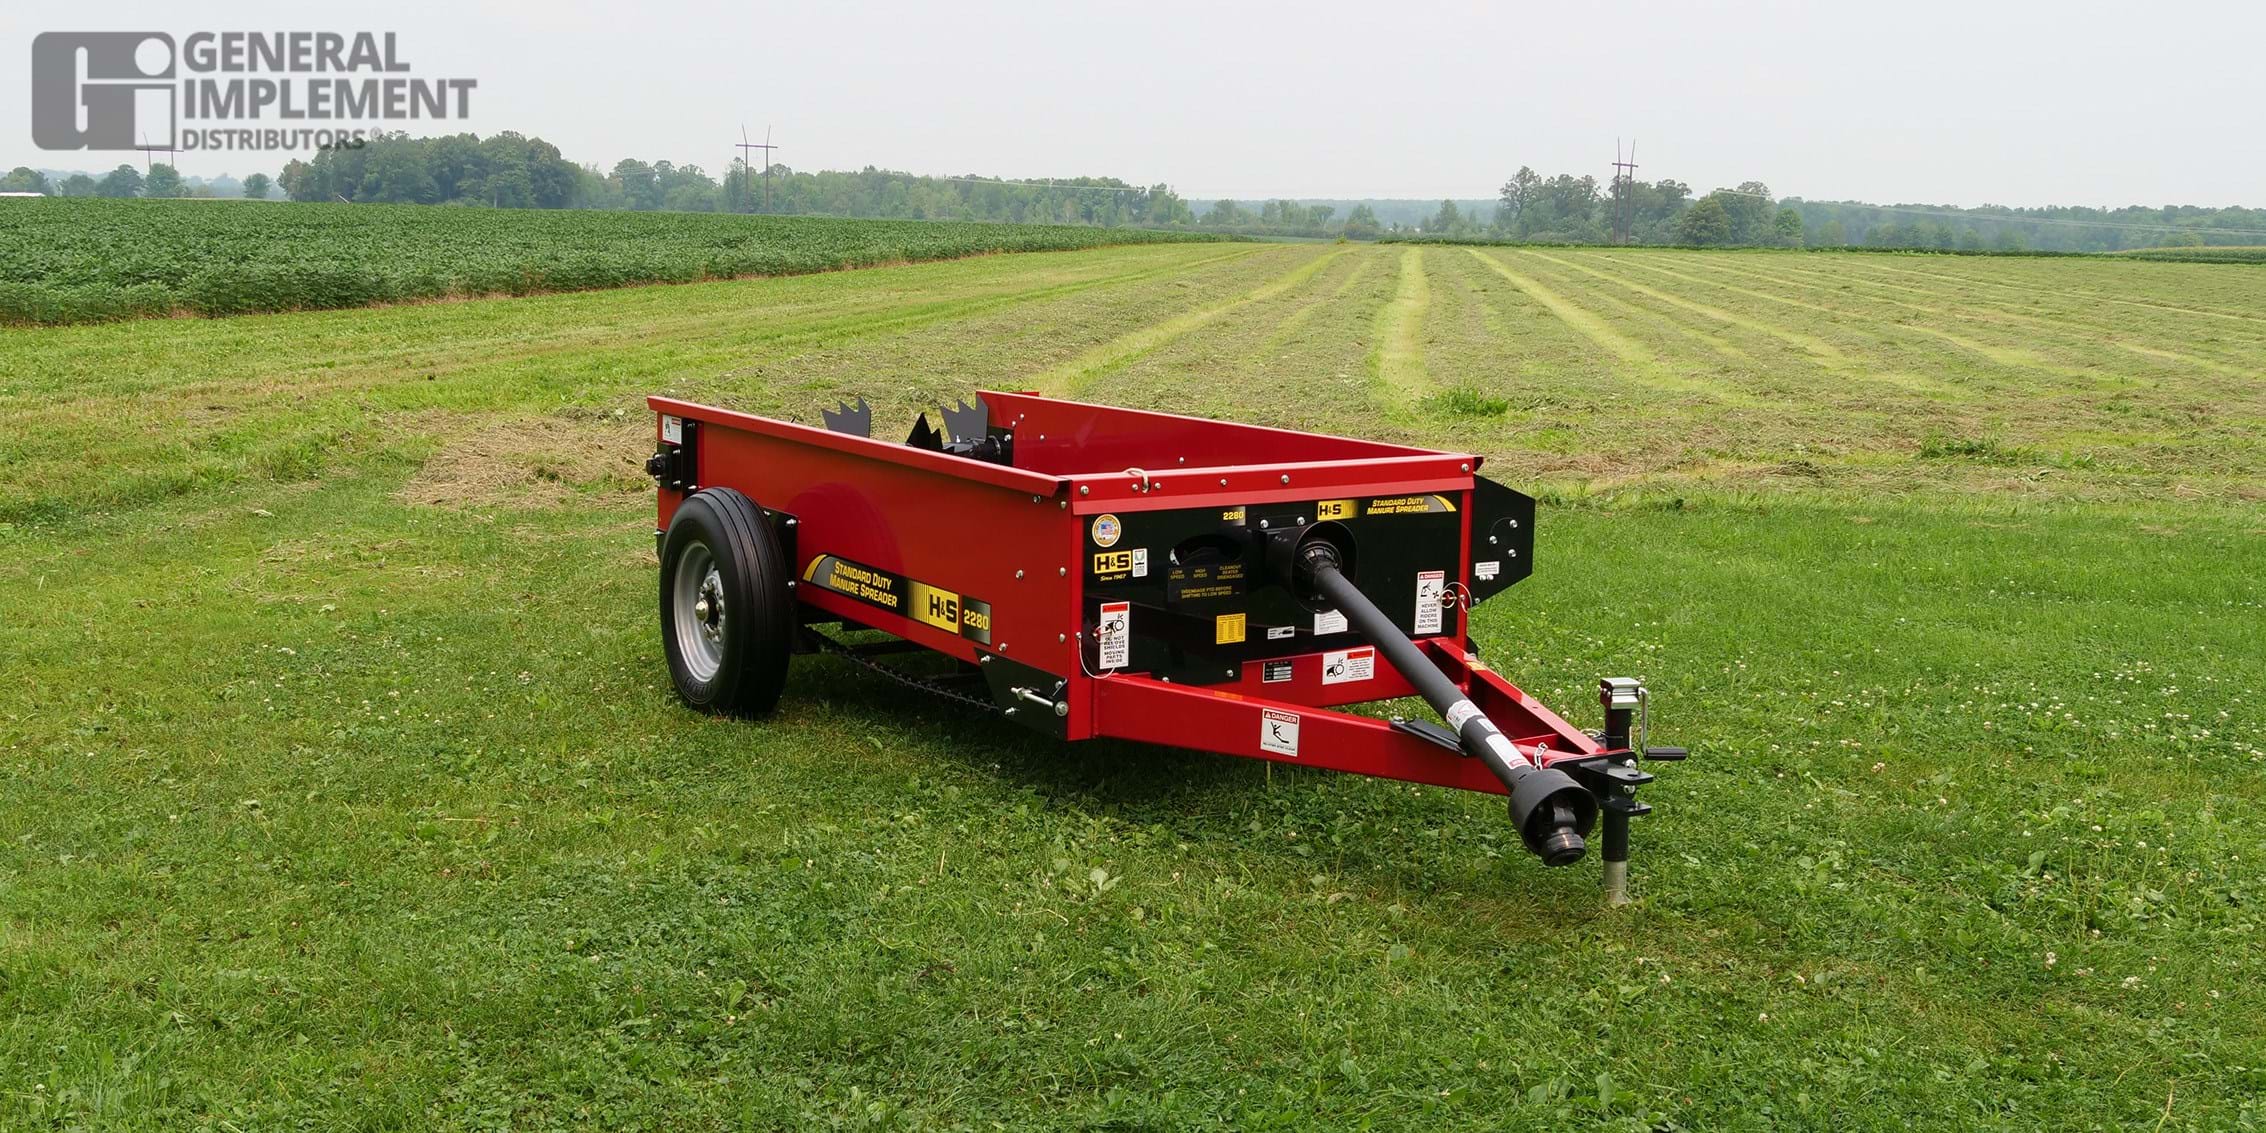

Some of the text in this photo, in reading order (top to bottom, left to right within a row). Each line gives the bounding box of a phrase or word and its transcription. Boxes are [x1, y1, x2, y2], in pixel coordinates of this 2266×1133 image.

[1366, 504, 1429, 515] MANURE SPREADER
[1372, 497, 1425, 507] STANDARD DUTY
[1223, 511, 1244, 520] 2280
[1319, 504, 1342, 516] H&S
[1096, 553, 1130, 571] H&S
[834, 561, 892, 590] STANDARD DUTY
[829, 573, 898, 608] MANURE SPREADER
[929, 594, 957, 623] H&S
[963, 609, 989, 631] 2280
[1271, 713, 1297, 723] DANGER
